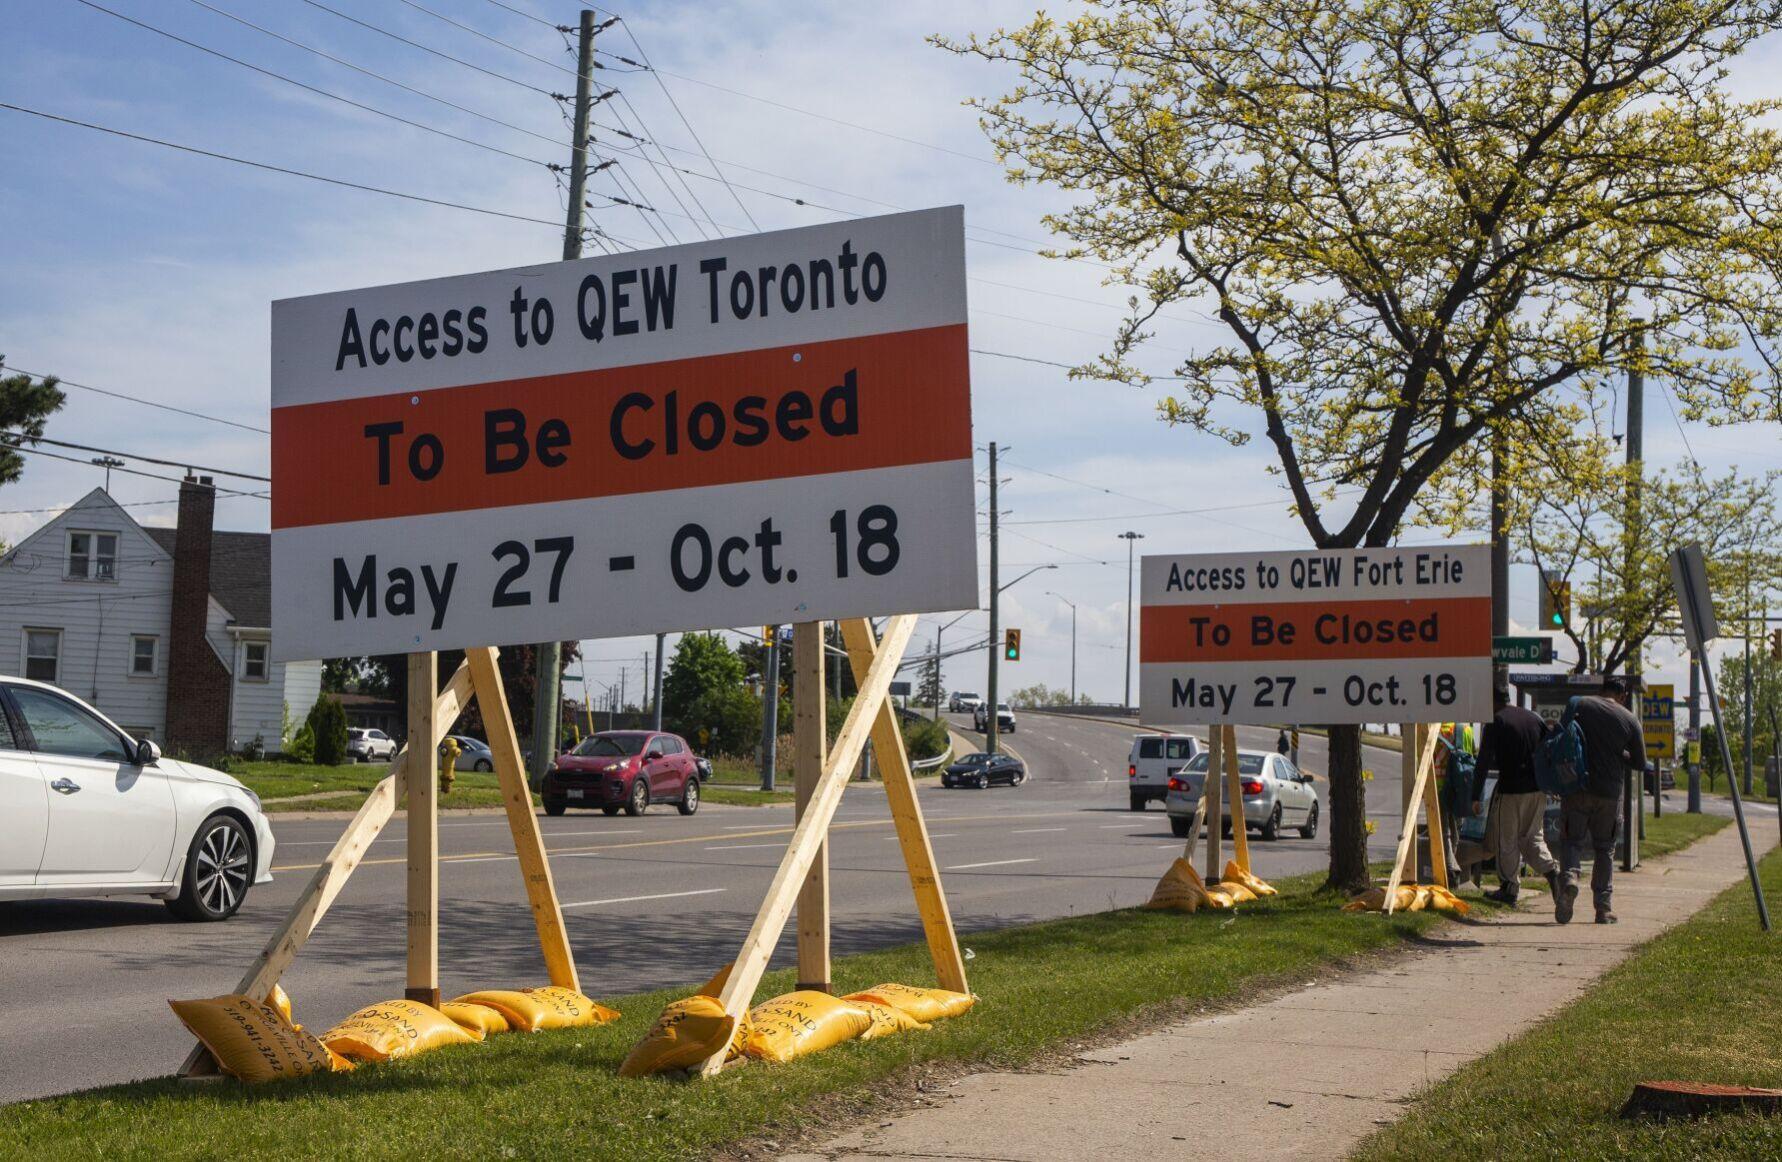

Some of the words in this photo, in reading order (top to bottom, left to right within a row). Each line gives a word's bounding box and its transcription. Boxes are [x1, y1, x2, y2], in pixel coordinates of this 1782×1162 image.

[336, 307, 487, 371] Access
[511, 287, 555, 347] to
[578, 264, 678, 344] QEW
[700, 240, 887, 326] Toronto
[364, 421, 445, 486] To
[485, 408, 571, 475] Be
[610, 368, 859, 461] Closed
[334, 555, 458, 631] May
[492, 537, 574, 609] 27
[609, 555, 635, 572] -
[671, 518, 798, 593] Oct.
[830, 505, 901, 579] 18
[1166, 563, 1246, 592] Access
[1257, 560, 1279, 589] to
[1290, 557, 1342, 590] QEW
[1353, 556, 1404, 587] Fort
[1415, 554, 1463, 585] Erie
[1189, 617, 1231, 648] To
[1251, 615, 1296, 646] Be
[1314, 611, 1440, 645] Closed
[1492, 645, 1525, 659] wvale
[1171, 678, 1237, 716] May
[1254, 676, 1297, 708] 27
[1312, 687, 1327, 695] -
[1343, 674, 1408, 707] Oct.
[1423, 673, 1457, 706] 18
